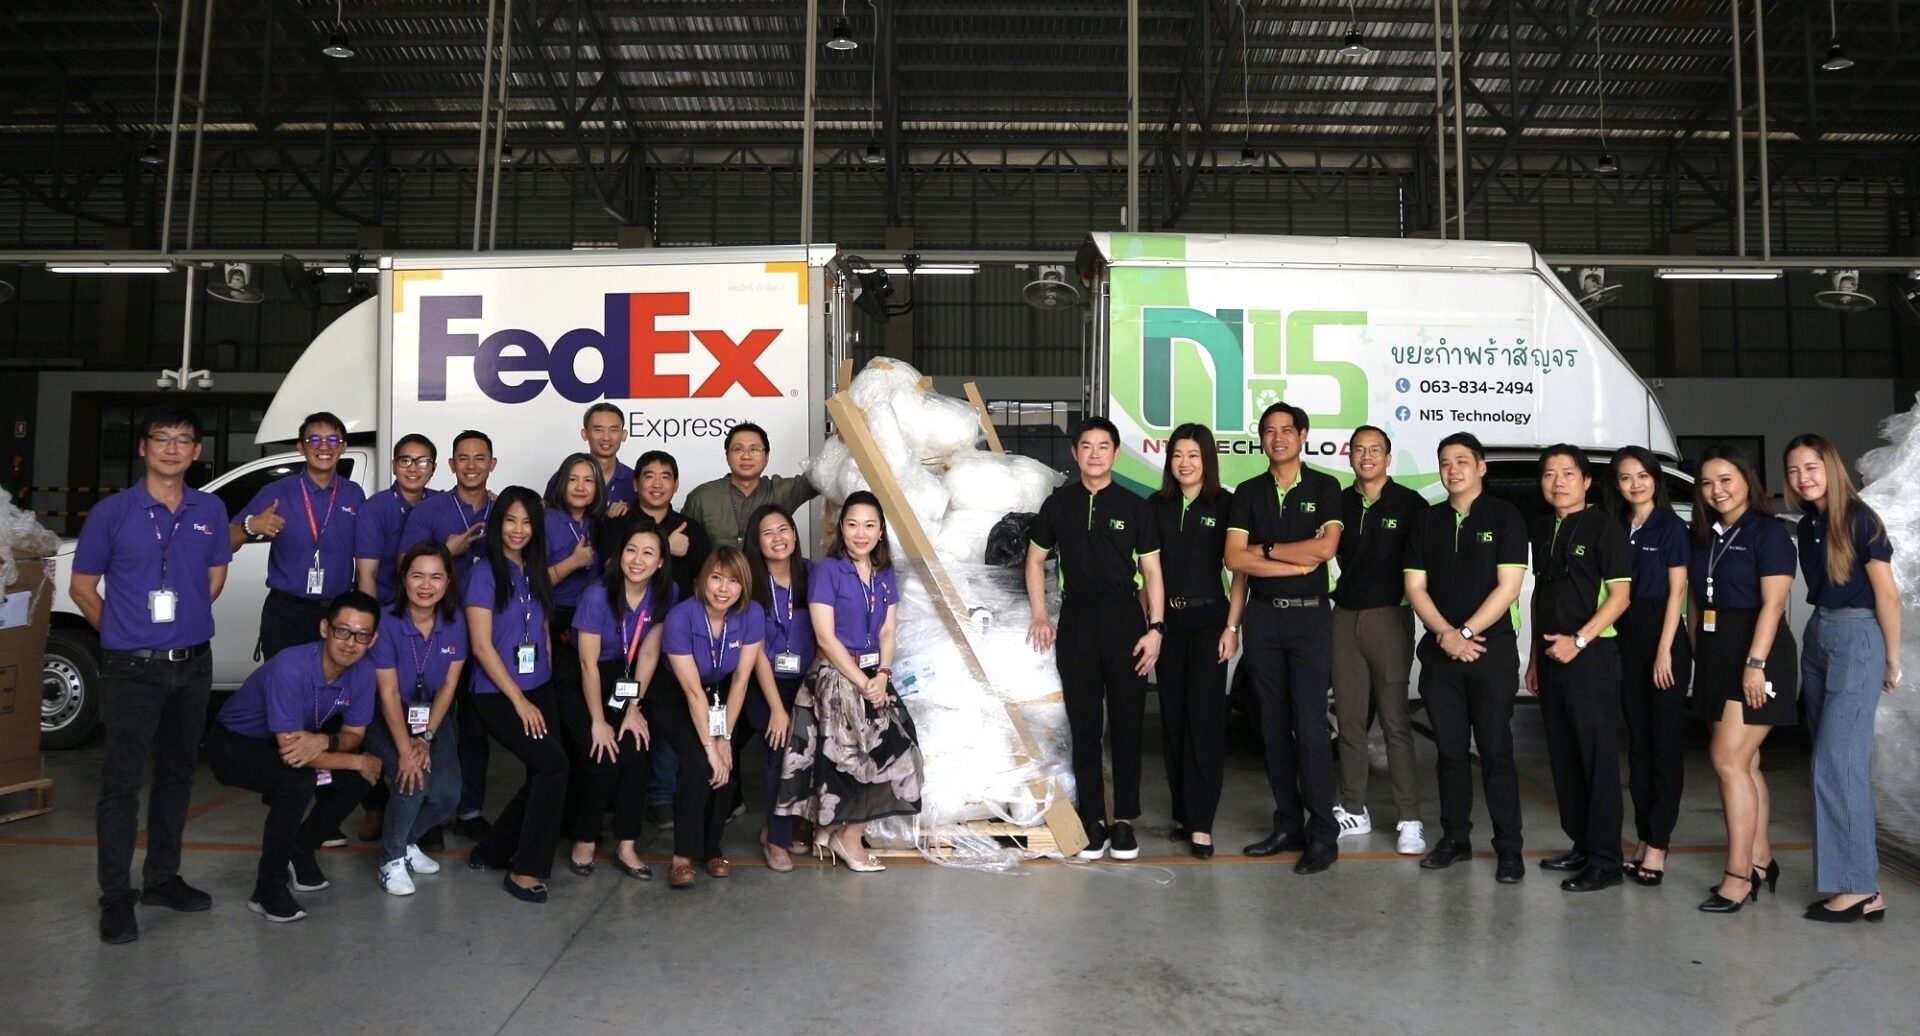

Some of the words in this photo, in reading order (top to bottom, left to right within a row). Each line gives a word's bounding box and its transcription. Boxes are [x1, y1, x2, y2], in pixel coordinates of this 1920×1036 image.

[418, 292, 784, 404] FedEx
[1391, 337, 1579, 375] ขยะกำพร้าสัญจร
[1419, 380, 1534, 394] 063-834-2494
[629, 411, 737, 444] Express
[1419, 409, 1444, 421] N15
[1450, 409, 1532, 425] Technology
